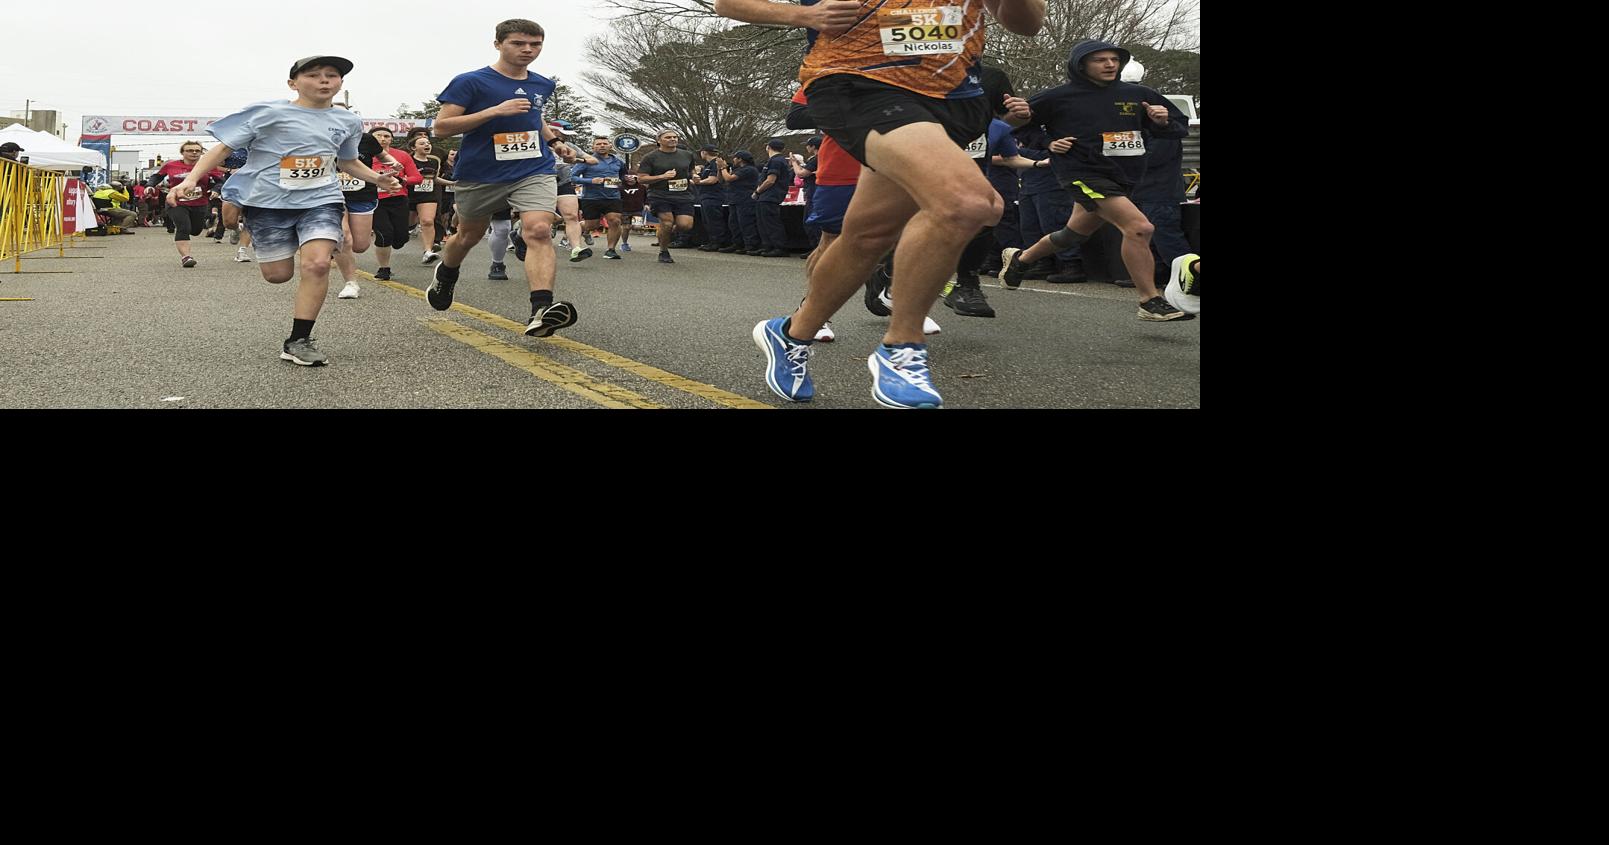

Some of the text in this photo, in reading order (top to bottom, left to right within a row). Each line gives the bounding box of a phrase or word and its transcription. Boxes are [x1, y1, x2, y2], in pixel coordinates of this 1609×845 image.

[911, 14, 938, 26] 5K
[891, 25, 958, 42] 5040
[904, 43, 953, 52] Nickolas
[122, 119, 198, 132] COAST
[505, 134, 525, 143] 5K
[500, 141, 537, 153] 3454
[1109, 140, 1142, 149] 3468
[294, 158, 318, 168] 5K
[289, 167, 326, 178] 3391
